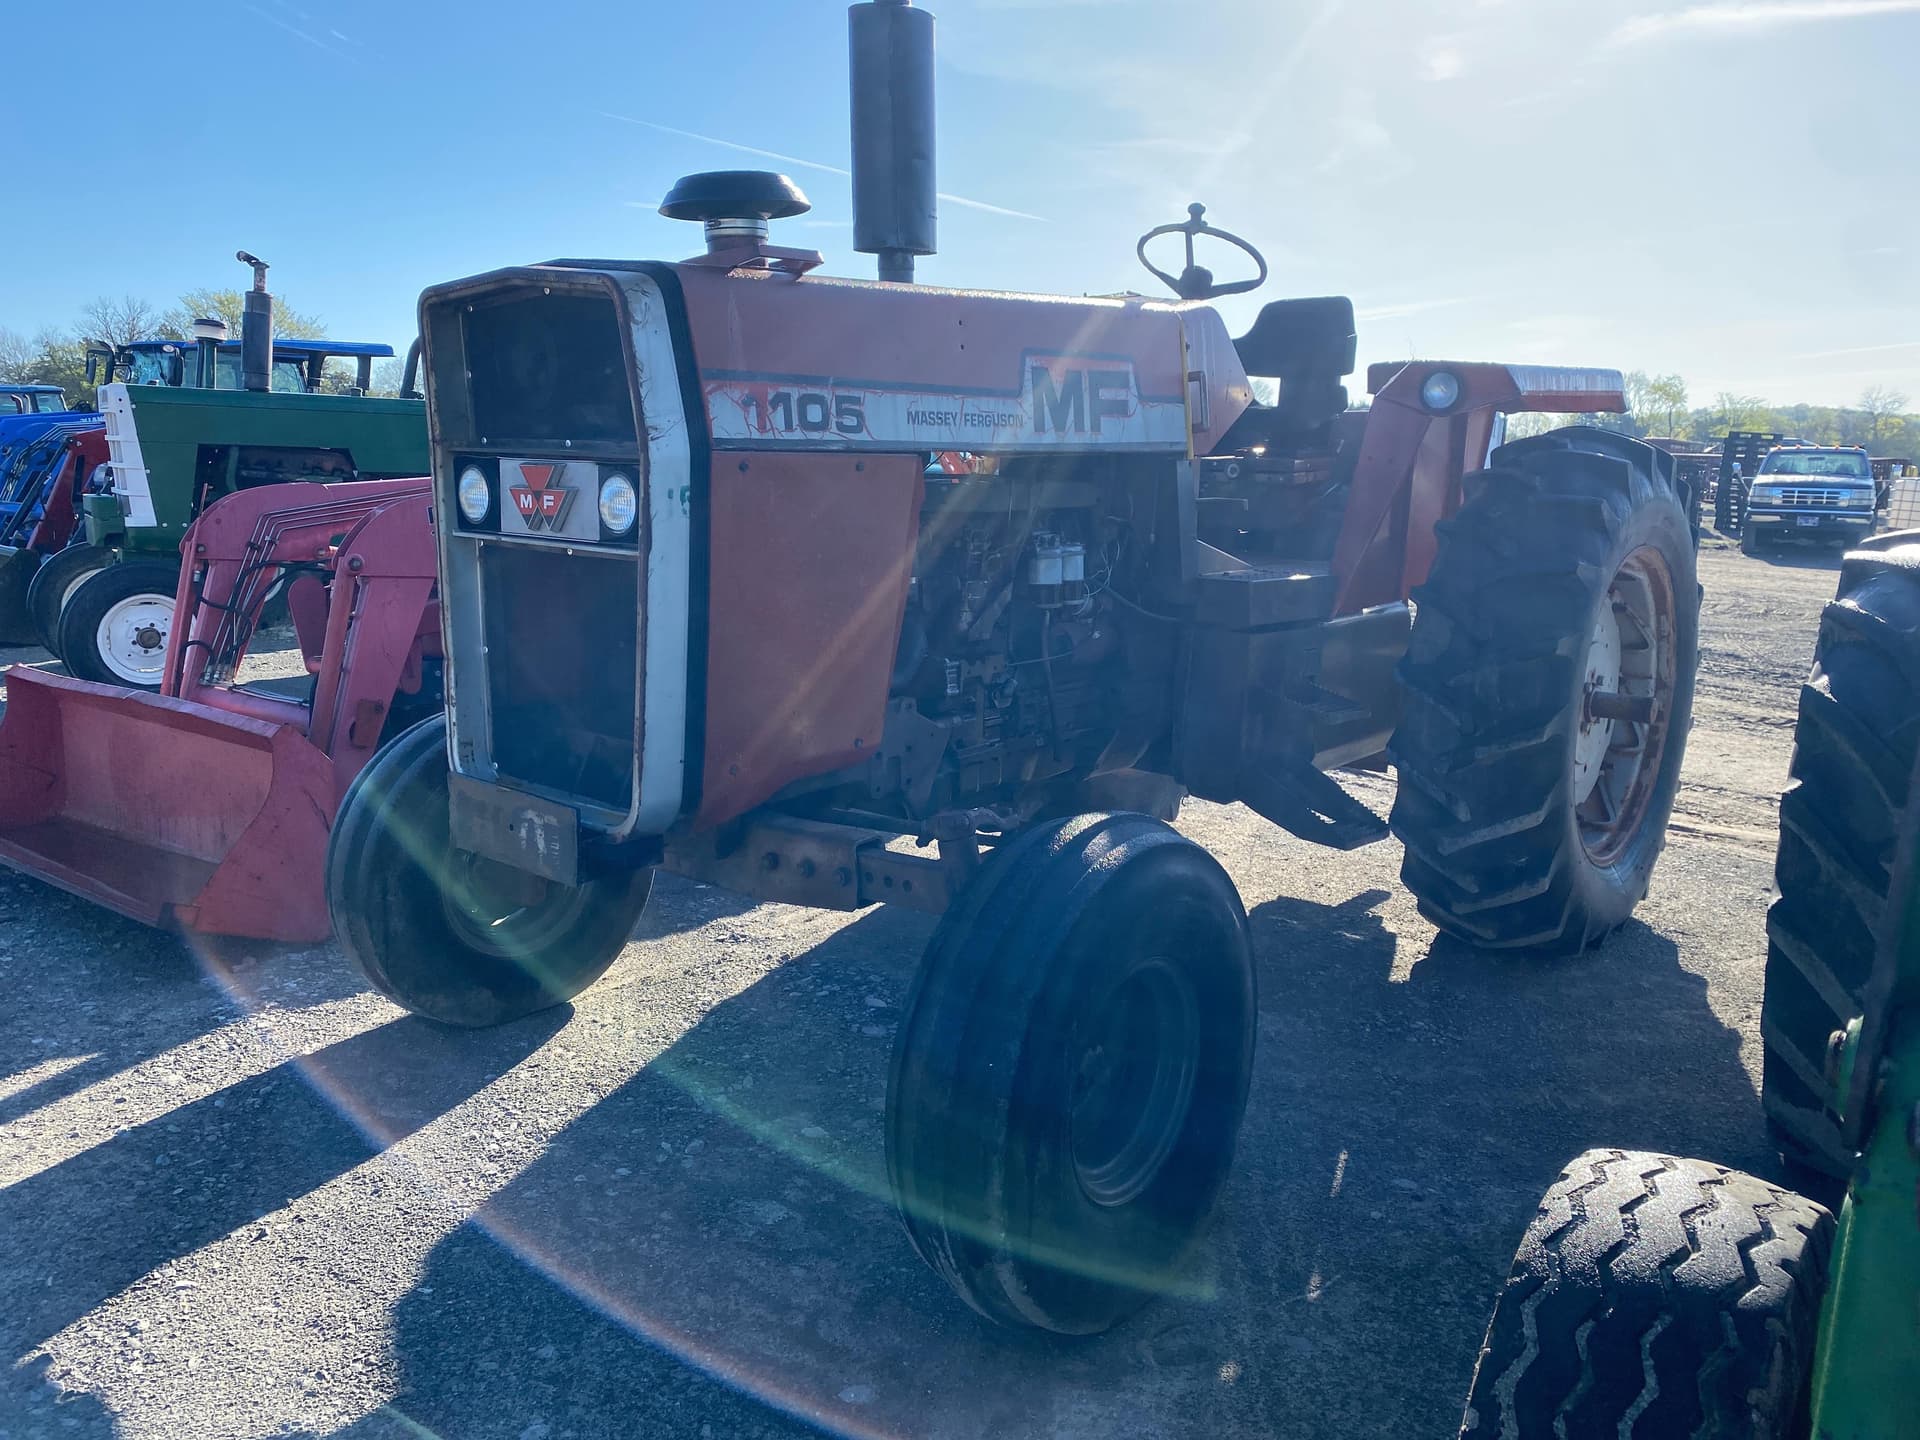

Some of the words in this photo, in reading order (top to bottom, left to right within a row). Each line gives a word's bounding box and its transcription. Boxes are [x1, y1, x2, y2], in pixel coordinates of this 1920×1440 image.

[741, 390, 864, 433] 1105
[907, 409, 957, 426] MASSEY
[1032, 366, 1129, 432] MF
